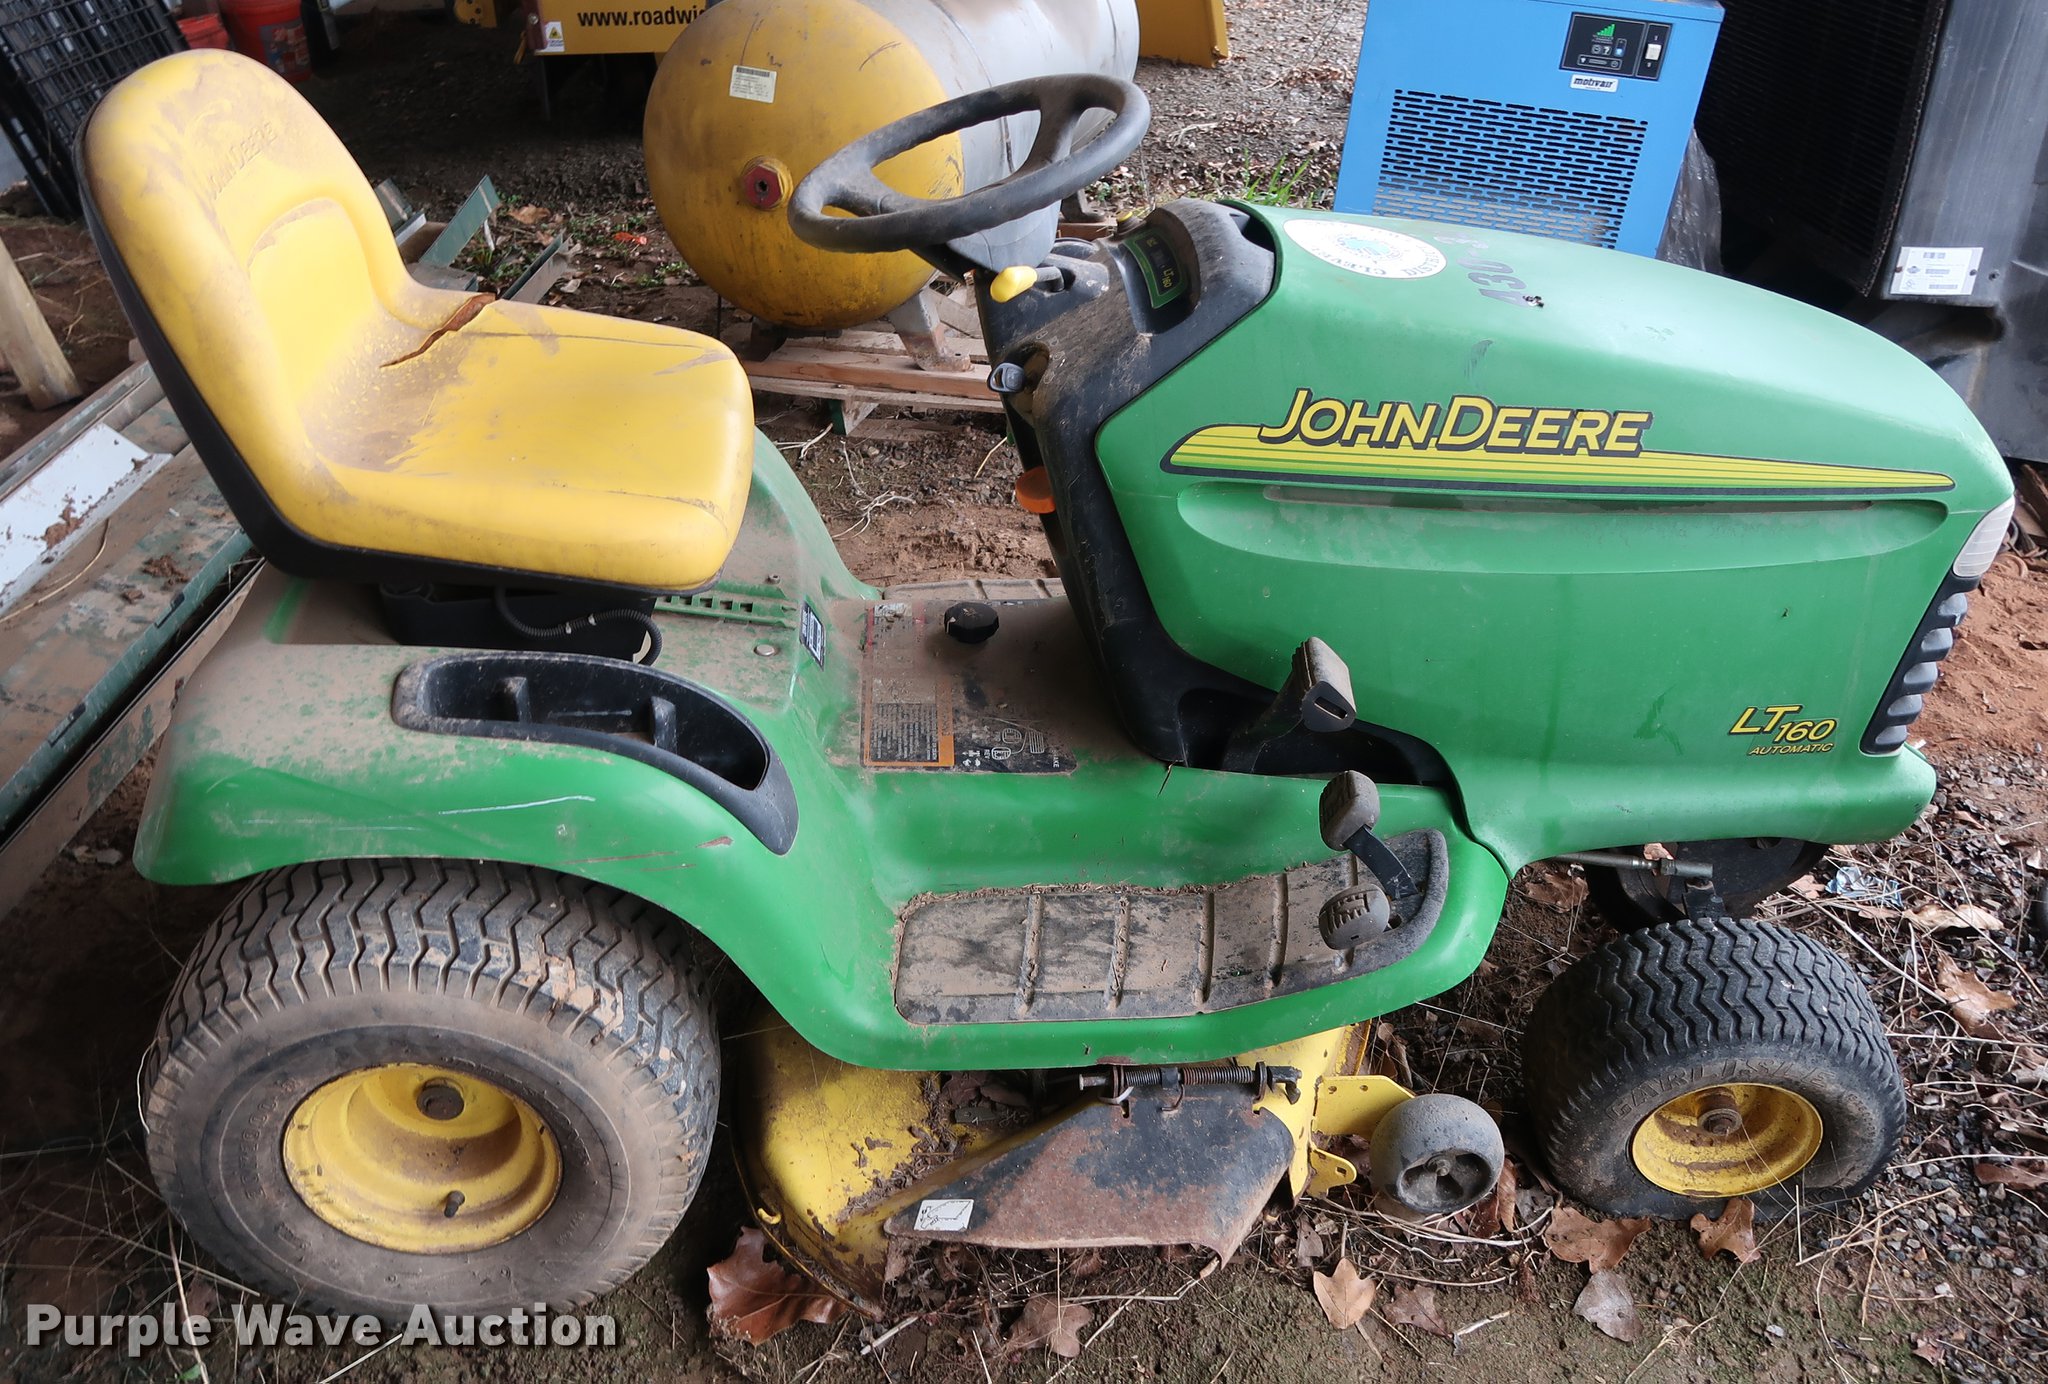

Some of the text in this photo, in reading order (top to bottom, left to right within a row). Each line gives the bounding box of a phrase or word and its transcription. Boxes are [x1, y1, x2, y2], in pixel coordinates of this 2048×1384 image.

[577, 5, 706, 26] www.roadwi
[1258, 388, 1653, 457] JOHN DEERE
[1747, 743, 1834, 756] AUTOMATIC
